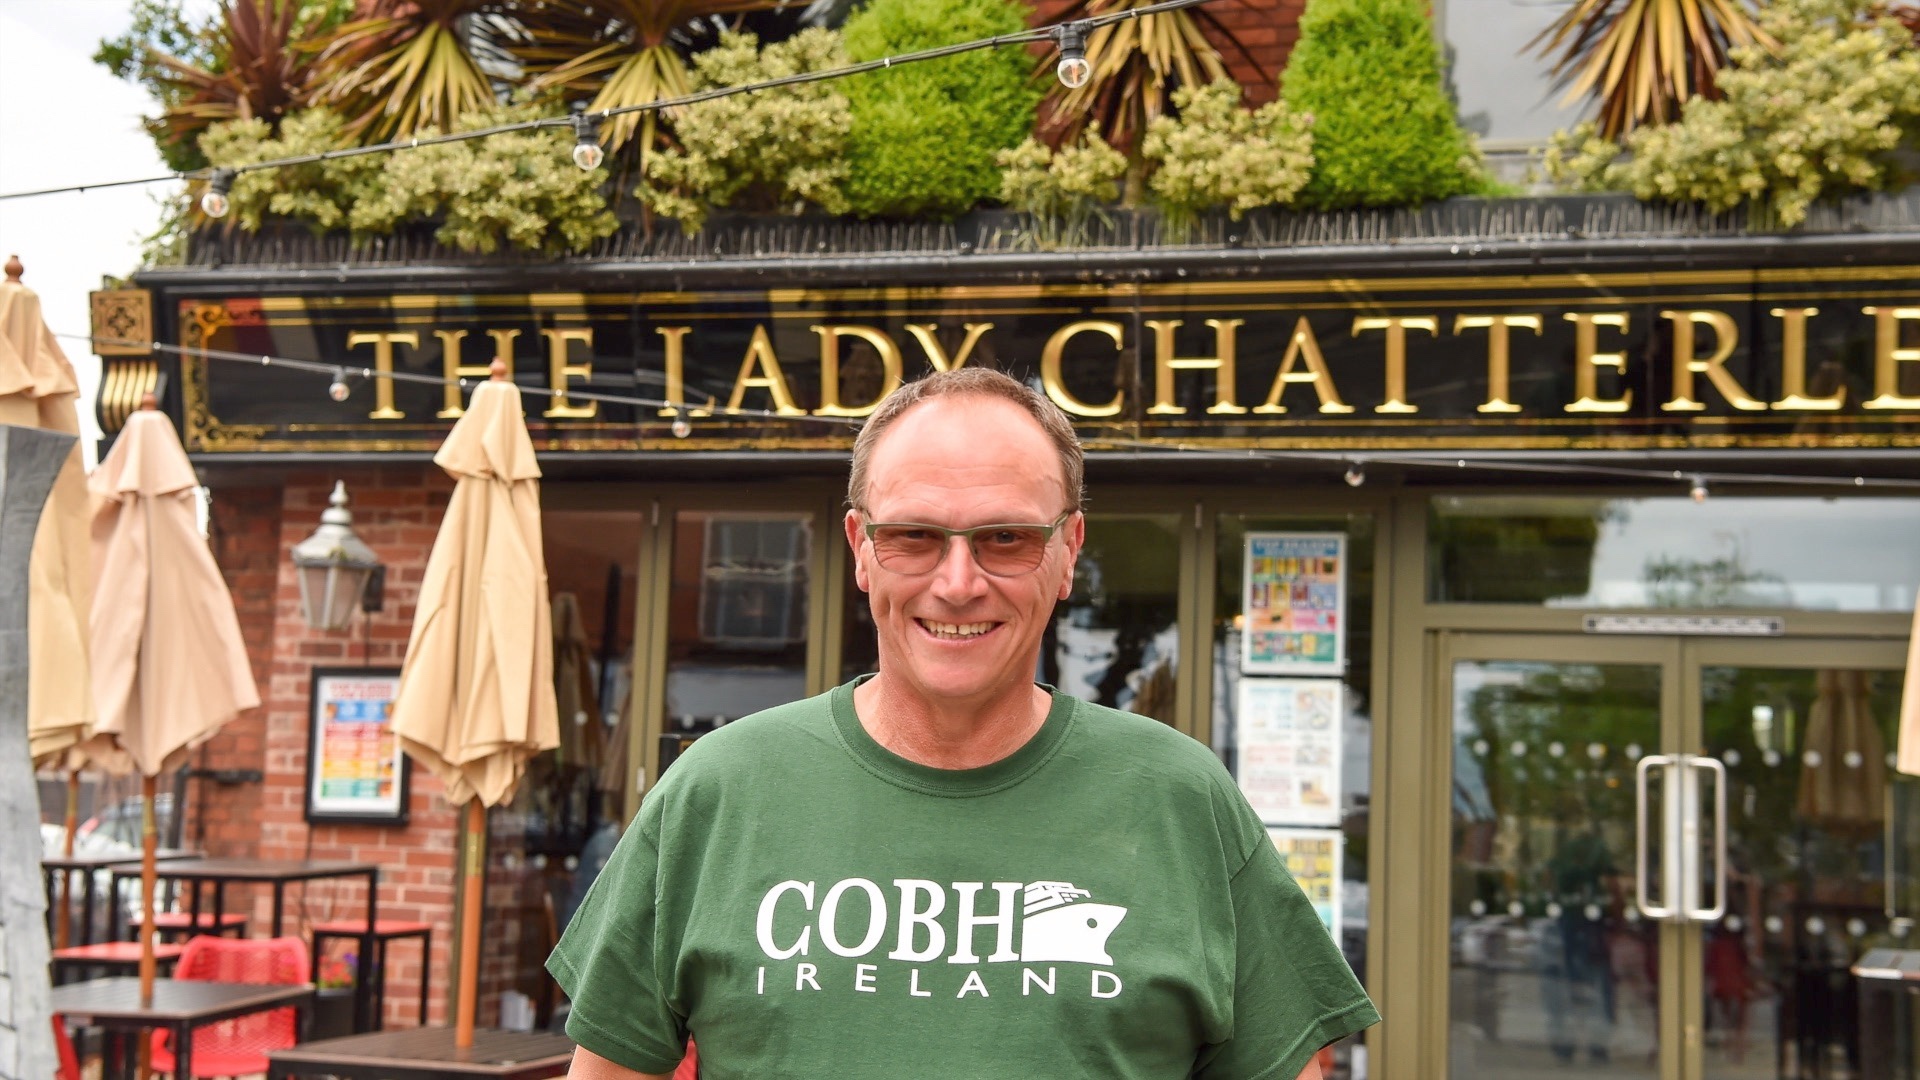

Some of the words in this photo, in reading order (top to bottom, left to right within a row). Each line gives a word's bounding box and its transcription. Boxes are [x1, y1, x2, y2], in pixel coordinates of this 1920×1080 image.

[347, 326, 598, 420] THE
[654, 322, 995, 418] LADY
[1039, 306, 1920, 417] CHATTERLE
[756, 877, 1023, 963] COBH
[757, 962, 1123, 999] IRELAND
